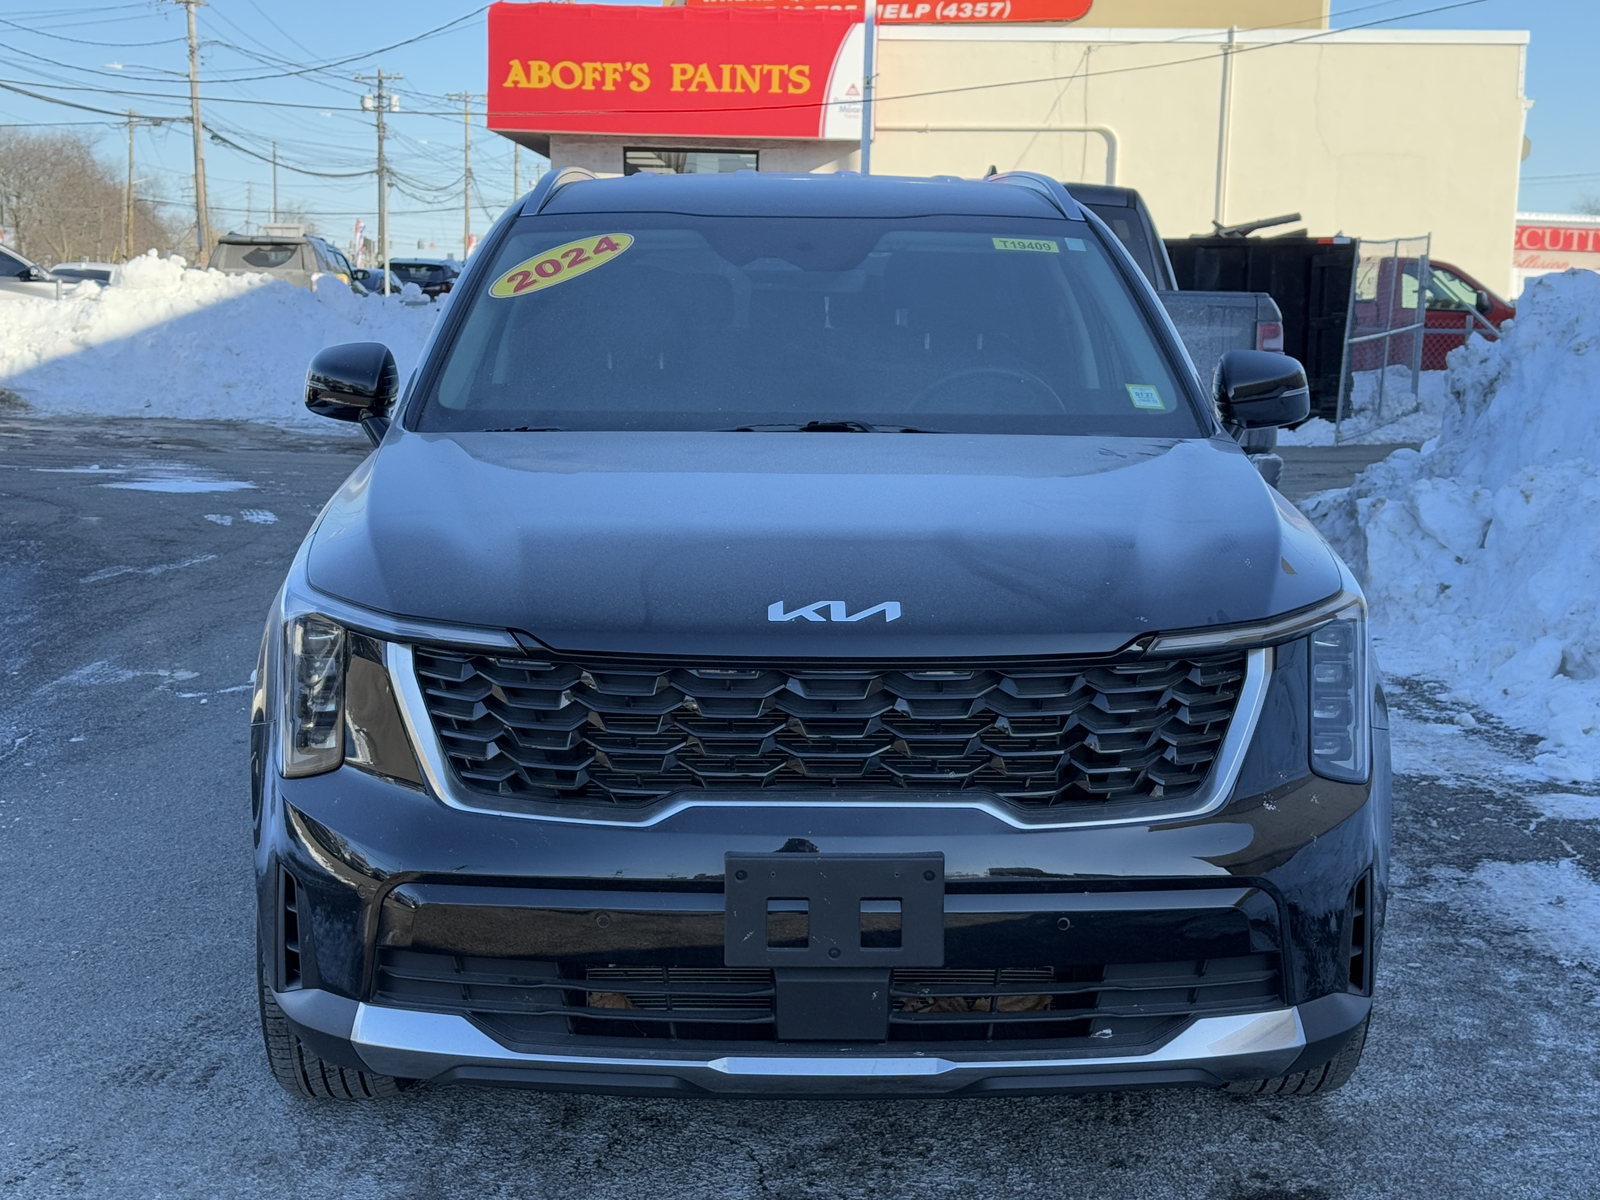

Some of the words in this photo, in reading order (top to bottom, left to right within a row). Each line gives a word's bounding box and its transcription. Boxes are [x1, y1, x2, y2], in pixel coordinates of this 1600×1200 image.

[935, 0, 1012, 20] (4357)
[502, 59, 651, 92] ABOFF'S
[669, 62, 811, 94] PAINTS
[999, 240, 1052, 251] T19409
[506, 236, 622, 293] 2024
